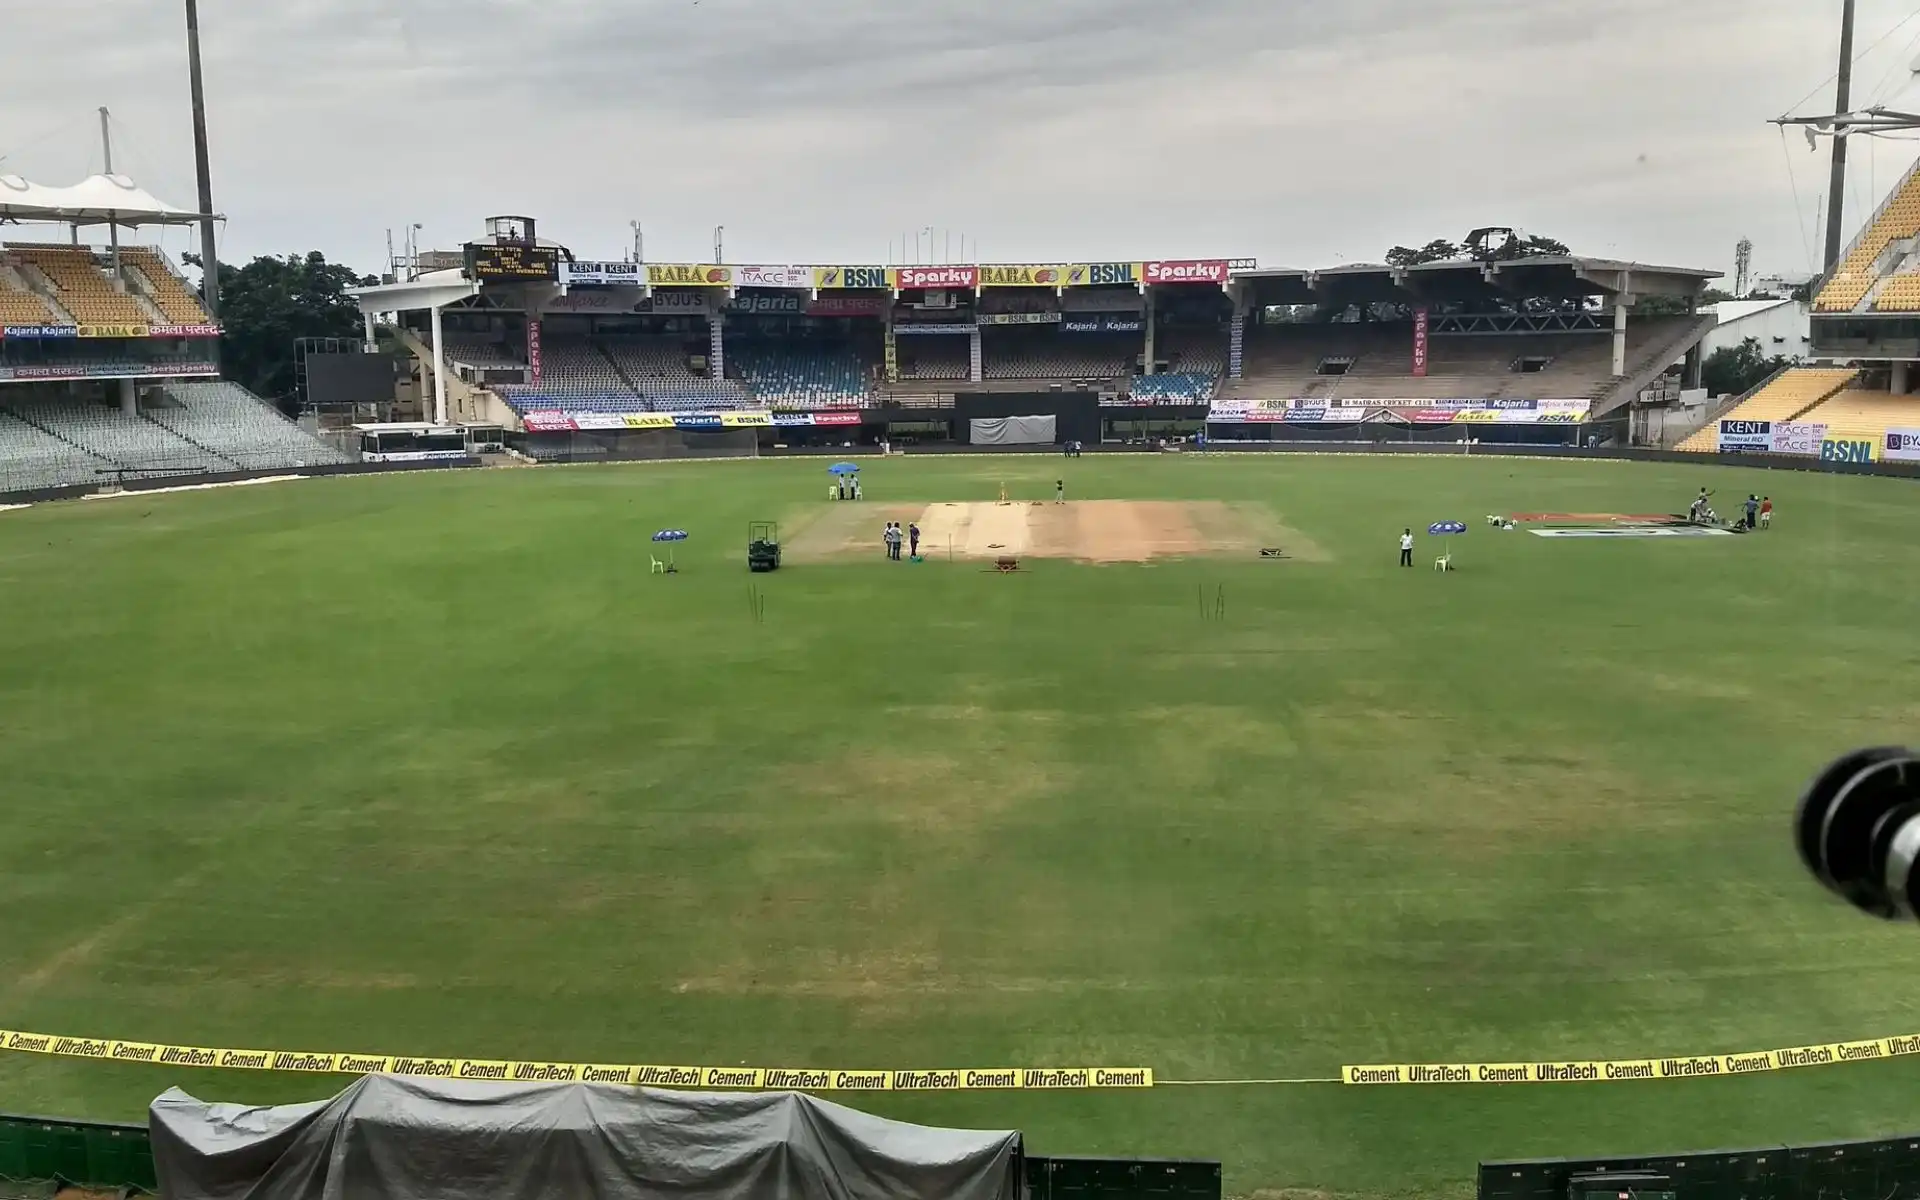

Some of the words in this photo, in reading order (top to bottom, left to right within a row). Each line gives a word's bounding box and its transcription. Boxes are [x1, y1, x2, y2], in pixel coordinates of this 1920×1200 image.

[573, 264, 596, 272] KENT
[610, 265, 633, 273] KENT
[1090, 264, 1138, 283] BSNL
[1148, 263, 1221, 279] Sparky
[648, 266, 705, 283] BABA
[844, 269, 891, 287] BSNL
[902, 269, 972, 285] Sparky
[981, 267, 1033, 283] BABA
[655, 293, 702, 306] BYJU'S
[1040, 314, 1061, 322] BSNL
[4, 326, 40, 336] Kajaria
[42, 326, 76, 336] Kajaria
[97, 327, 128, 335] BABA
[1066, 323, 1098, 331] Kajaria
[1107, 322, 1139, 330] Kajaria
[1267, 400, 1287, 408] BSNL
[675, 416, 720, 425] Kajaria
[737, 416, 767, 424] BSNL
[1727, 421, 1763, 432] KENT
[1822, 439, 1873, 463] BSNL
[9, 1033, 50, 1050] Cement
[54, 1037, 107, 1055] UltraTech
[112, 1042, 156, 1059] Cement
[160, 1046, 216, 1064] UltraTech
[221, 1051, 267, 1067] Cement
[275, 1054, 332, 1071] UltraTech
[339, 1056, 386, 1072] Cement
[393, 1057, 452, 1075] UltraTech
[460, 1062, 507, 1078] Cement
[514, 1062, 575, 1080] UltraTech
[582, 1066, 629, 1082] Cement
[637, 1066, 698, 1084] UltraTech
[708, 1068, 756, 1085] Cement
[766, 1070, 828, 1087] UltraTech
[836, 1072, 886, 1088] Cement
[895, 1071, 958, 1088] UltraTech
[966, 1070, 1015, 1086] Cement
[1025, 1070, 1087, 1086] UltraTech
[1095, 1068, 1144, 1085] Cement
[1351, 1066, 1400, 1082] Cement
[1408, 1065, 1470, 1081] UltraTech
[1479, 1064, 1528, 1080] Cement
[1536, 1063, 1597, 1080] UltraTech
[1605, 1062, 1653, 1078] Cement
[1661, 1057, 1719, 1076] UltraTech
[1726, 1053, 1771, 1072] Cement
[1777, 1046, 1833, 1066] UltraTech
[1837, 1041, 1882, 1060] Cement
[1887, 1036, 1920, 1054] UltraT
